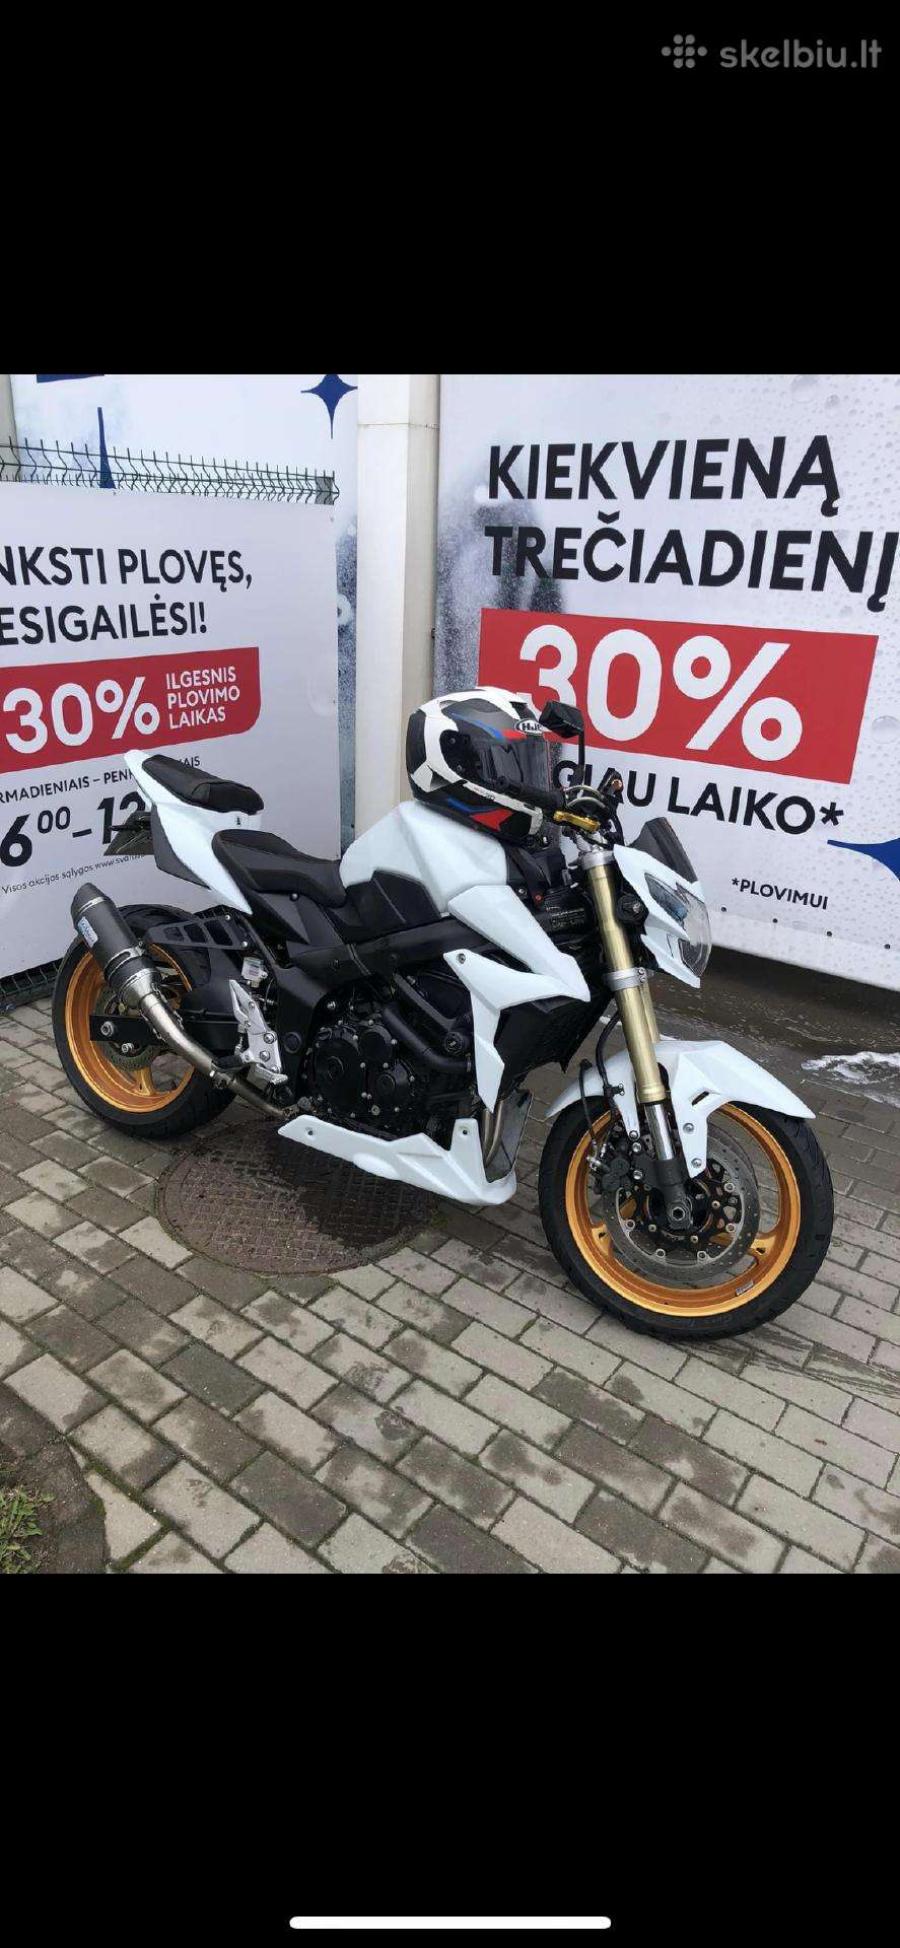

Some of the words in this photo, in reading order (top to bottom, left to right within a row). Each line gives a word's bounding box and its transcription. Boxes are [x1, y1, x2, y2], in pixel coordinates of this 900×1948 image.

[488, 434, 840, 517] KIEKVIENĄ
[118, 549, 252, 592] PLOVĘS,
[484, 510, 900, 612] TREČIADIENĮ
[0, 592, 207, 645] ESIGAILĖSI!
[166, 666, 237, 690] ILGESNIS
[167, 685, 241, 709] PLOVIMO
[518, 624, 804, 762] 30%
[2, 676, 160, 754] 30%
[169, 706, 227, 730] LAIKAS
[2, 885, 27, 894] Visos
